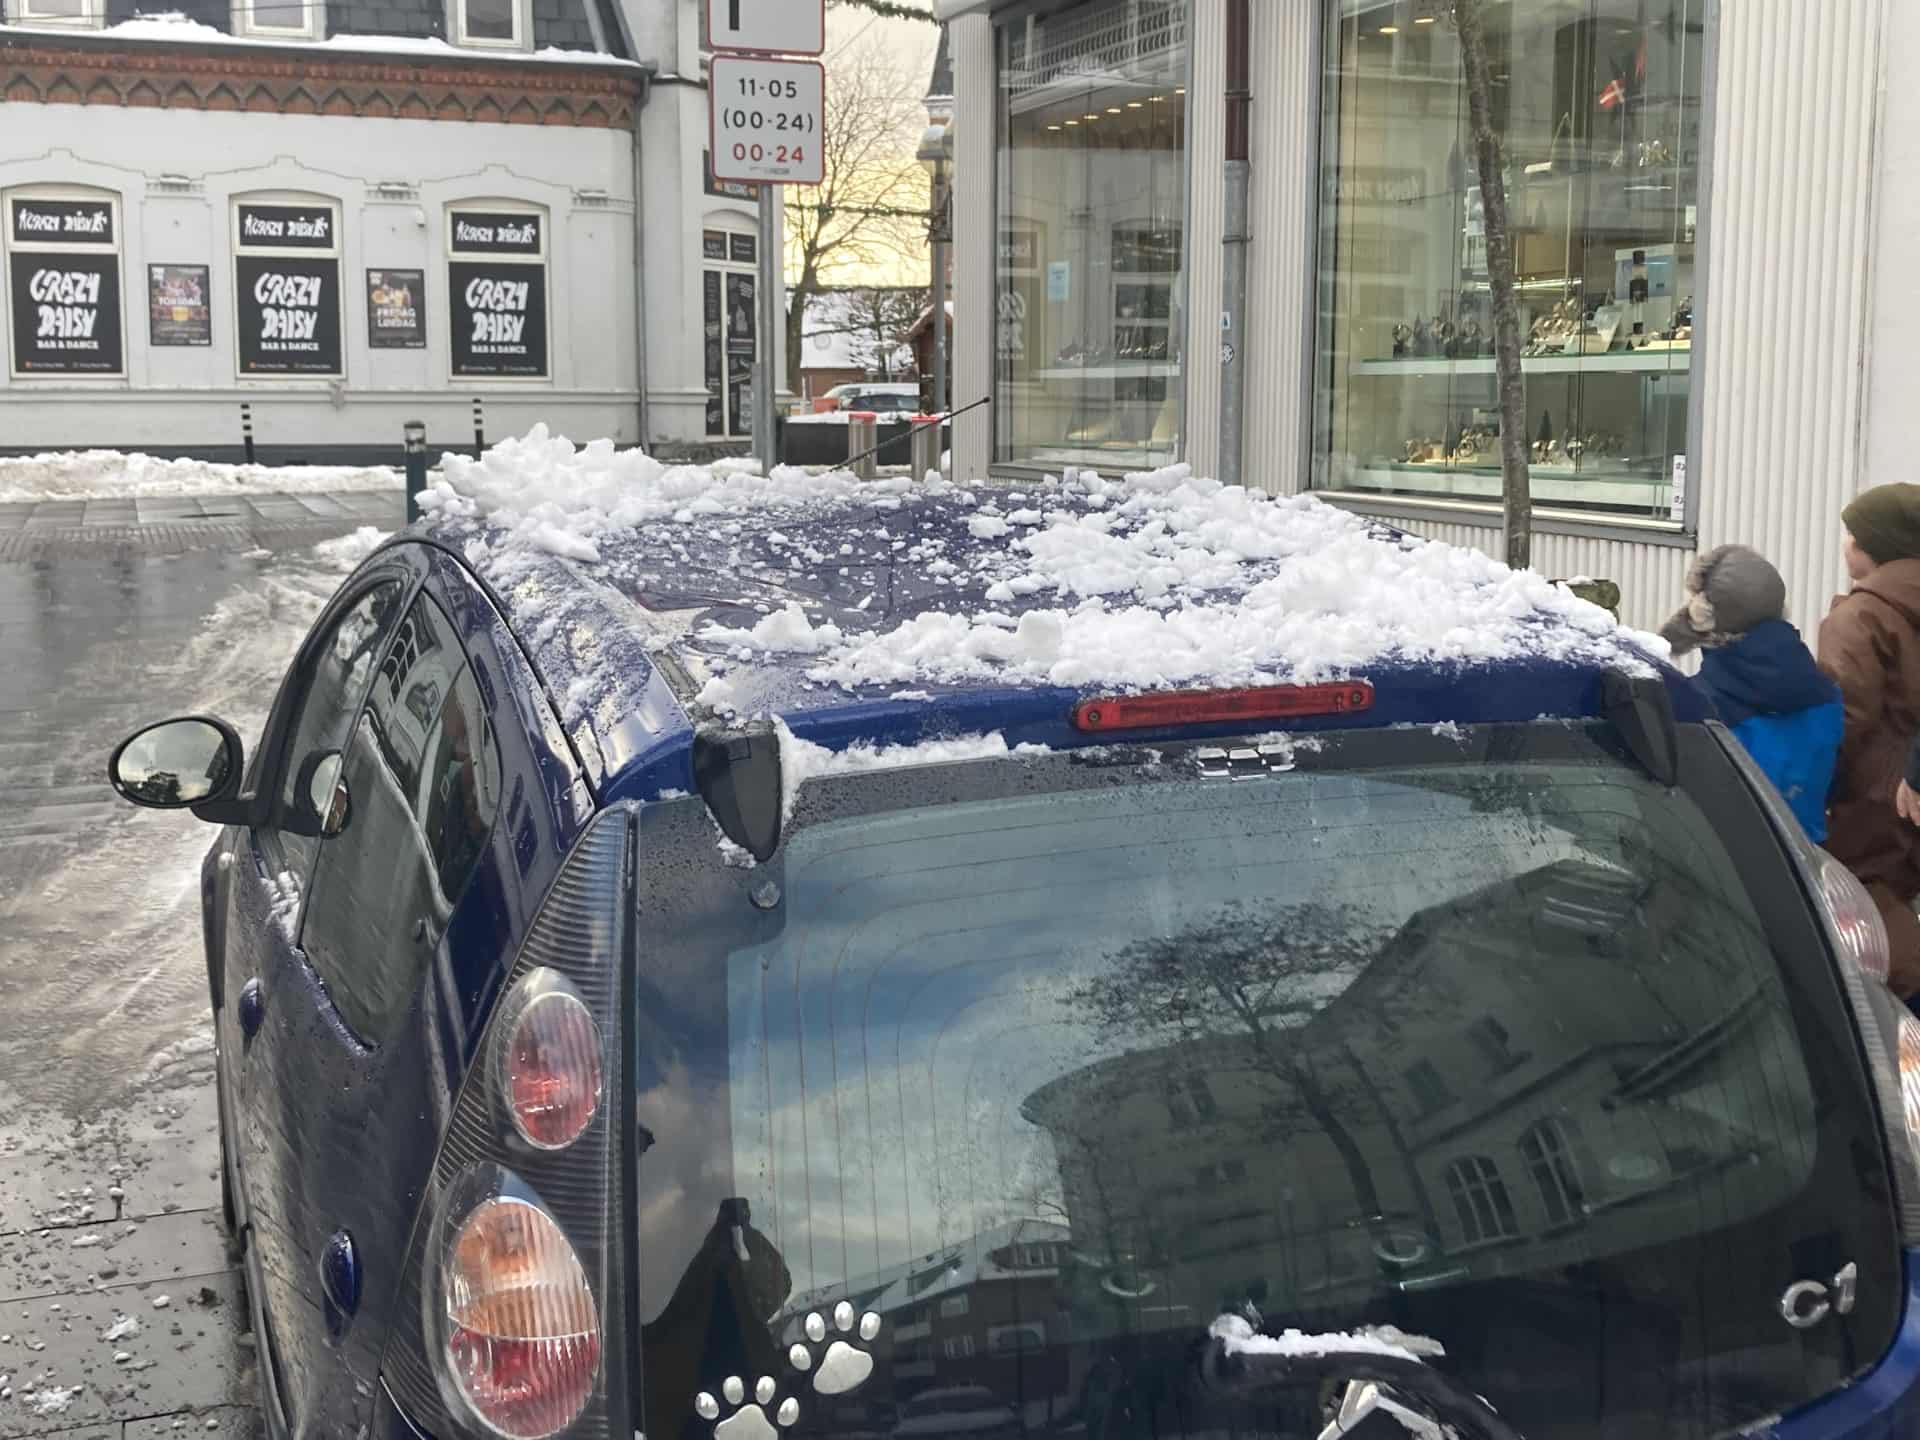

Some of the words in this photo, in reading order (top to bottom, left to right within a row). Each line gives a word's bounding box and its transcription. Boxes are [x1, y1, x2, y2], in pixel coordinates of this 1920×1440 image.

[30, 268, 100, 304] CRAZY
[254, 272, 322, 307] CRAZY
[465, 277, 529, 312] CRAZY
[37, 304, 97, 338] DAISY
[261, 306, 318, 340] DAISY
[471, 311, 526, 343] DAISY
[37, 340, 57, 349] BAR
[260, 341, 280, 350] BAR
[1781, 1261, 1857, 1328] C1
